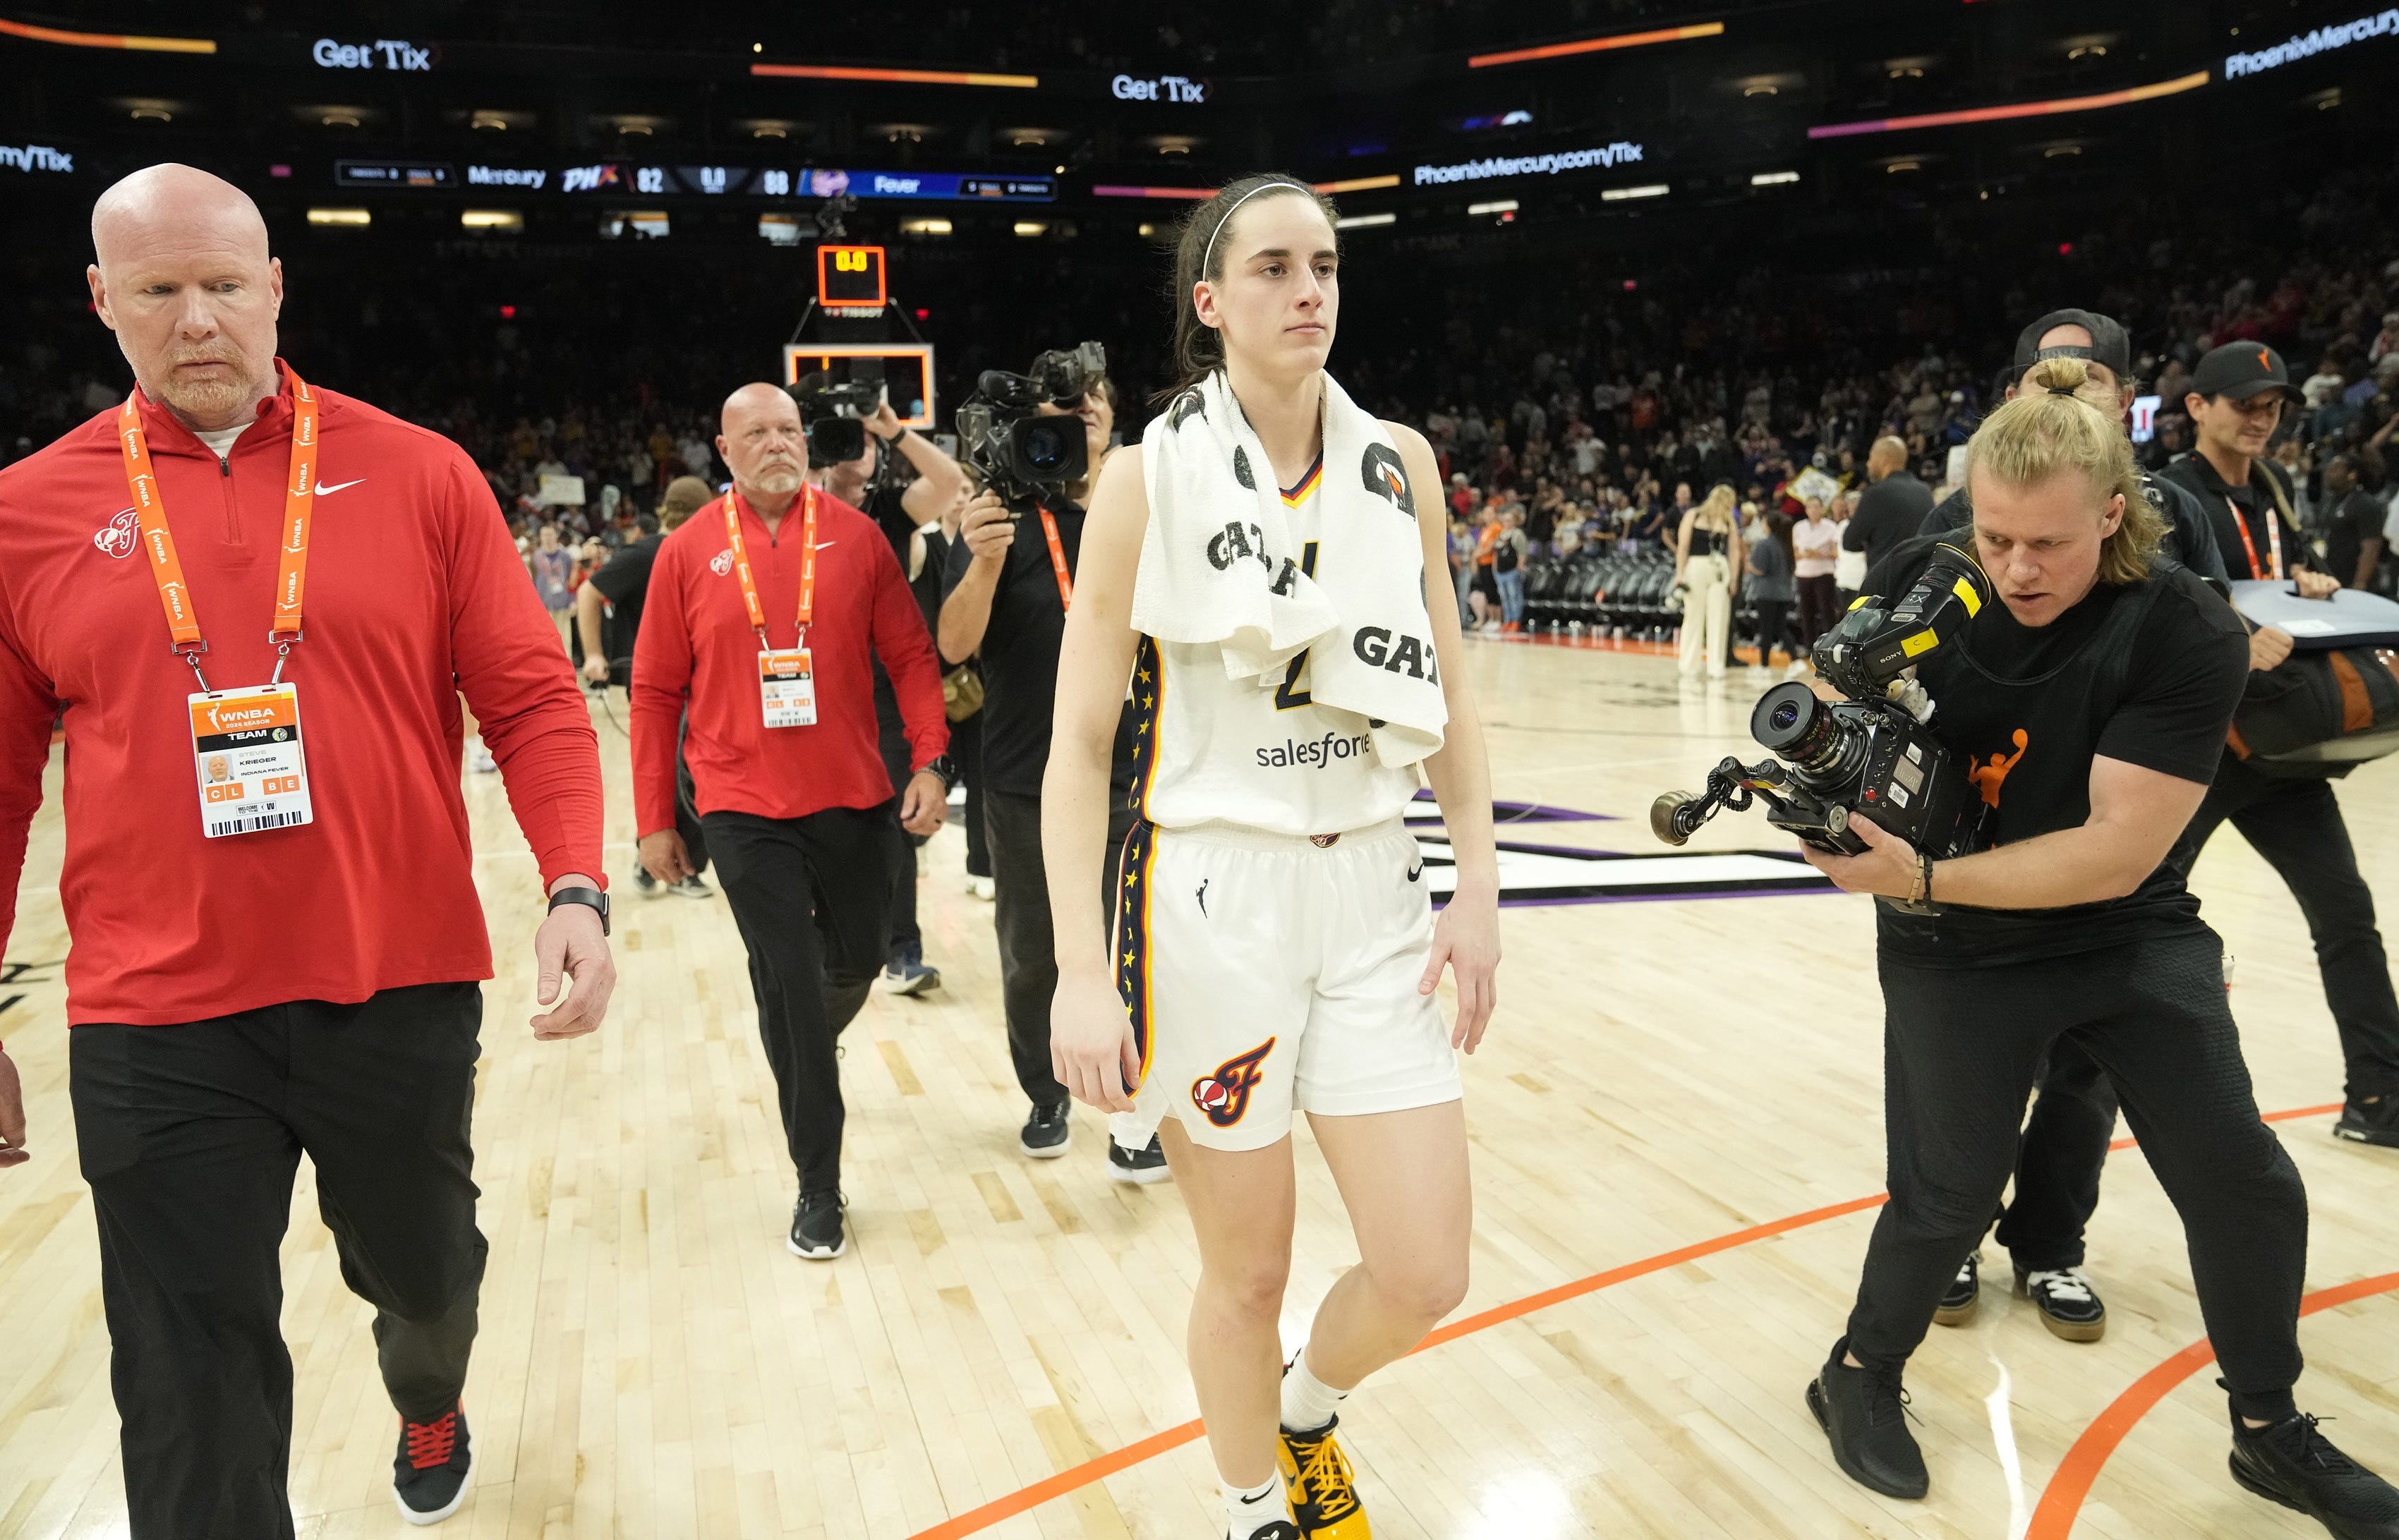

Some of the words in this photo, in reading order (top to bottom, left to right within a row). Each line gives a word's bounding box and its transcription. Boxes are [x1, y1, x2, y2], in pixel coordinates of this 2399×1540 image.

[313, 38, 373, 68] Get
[374, 39, 430, 71] Tix
[1112, 74, 1159, 100] Get
[1159, 75, 1204, 102] Tix
[468, 165, 547, 189] Mercury
[1414, 141, 1643, 186] PhoenixMercury.com/Tix
[303, 416, 311, 442] WNBA
[128, 433, 139, 461] WNBA
[298, 463, 308, 491] WNBA
[138, 480, 150, 507] WNBA
[293, 518, 303, 547] WNBA
[152, 534, 167, 564] WNBA
[287, 571, 297, 603] WNBA
[169, 588, 183, 620] WNBA
[1880, 650, 1902, 663] SONY
[219, 708, 275, 722] WNBA
[243, 719, 270, 727] SEASON
[227, 729, 267, 741] TEAM
[240, 757, 277, 766] KRIEGER
[211, 790, 221, 799] C
[231, 787, 239, 796] L
[268, 782, 277, 791] B
[287, 780, 296, 788] E
